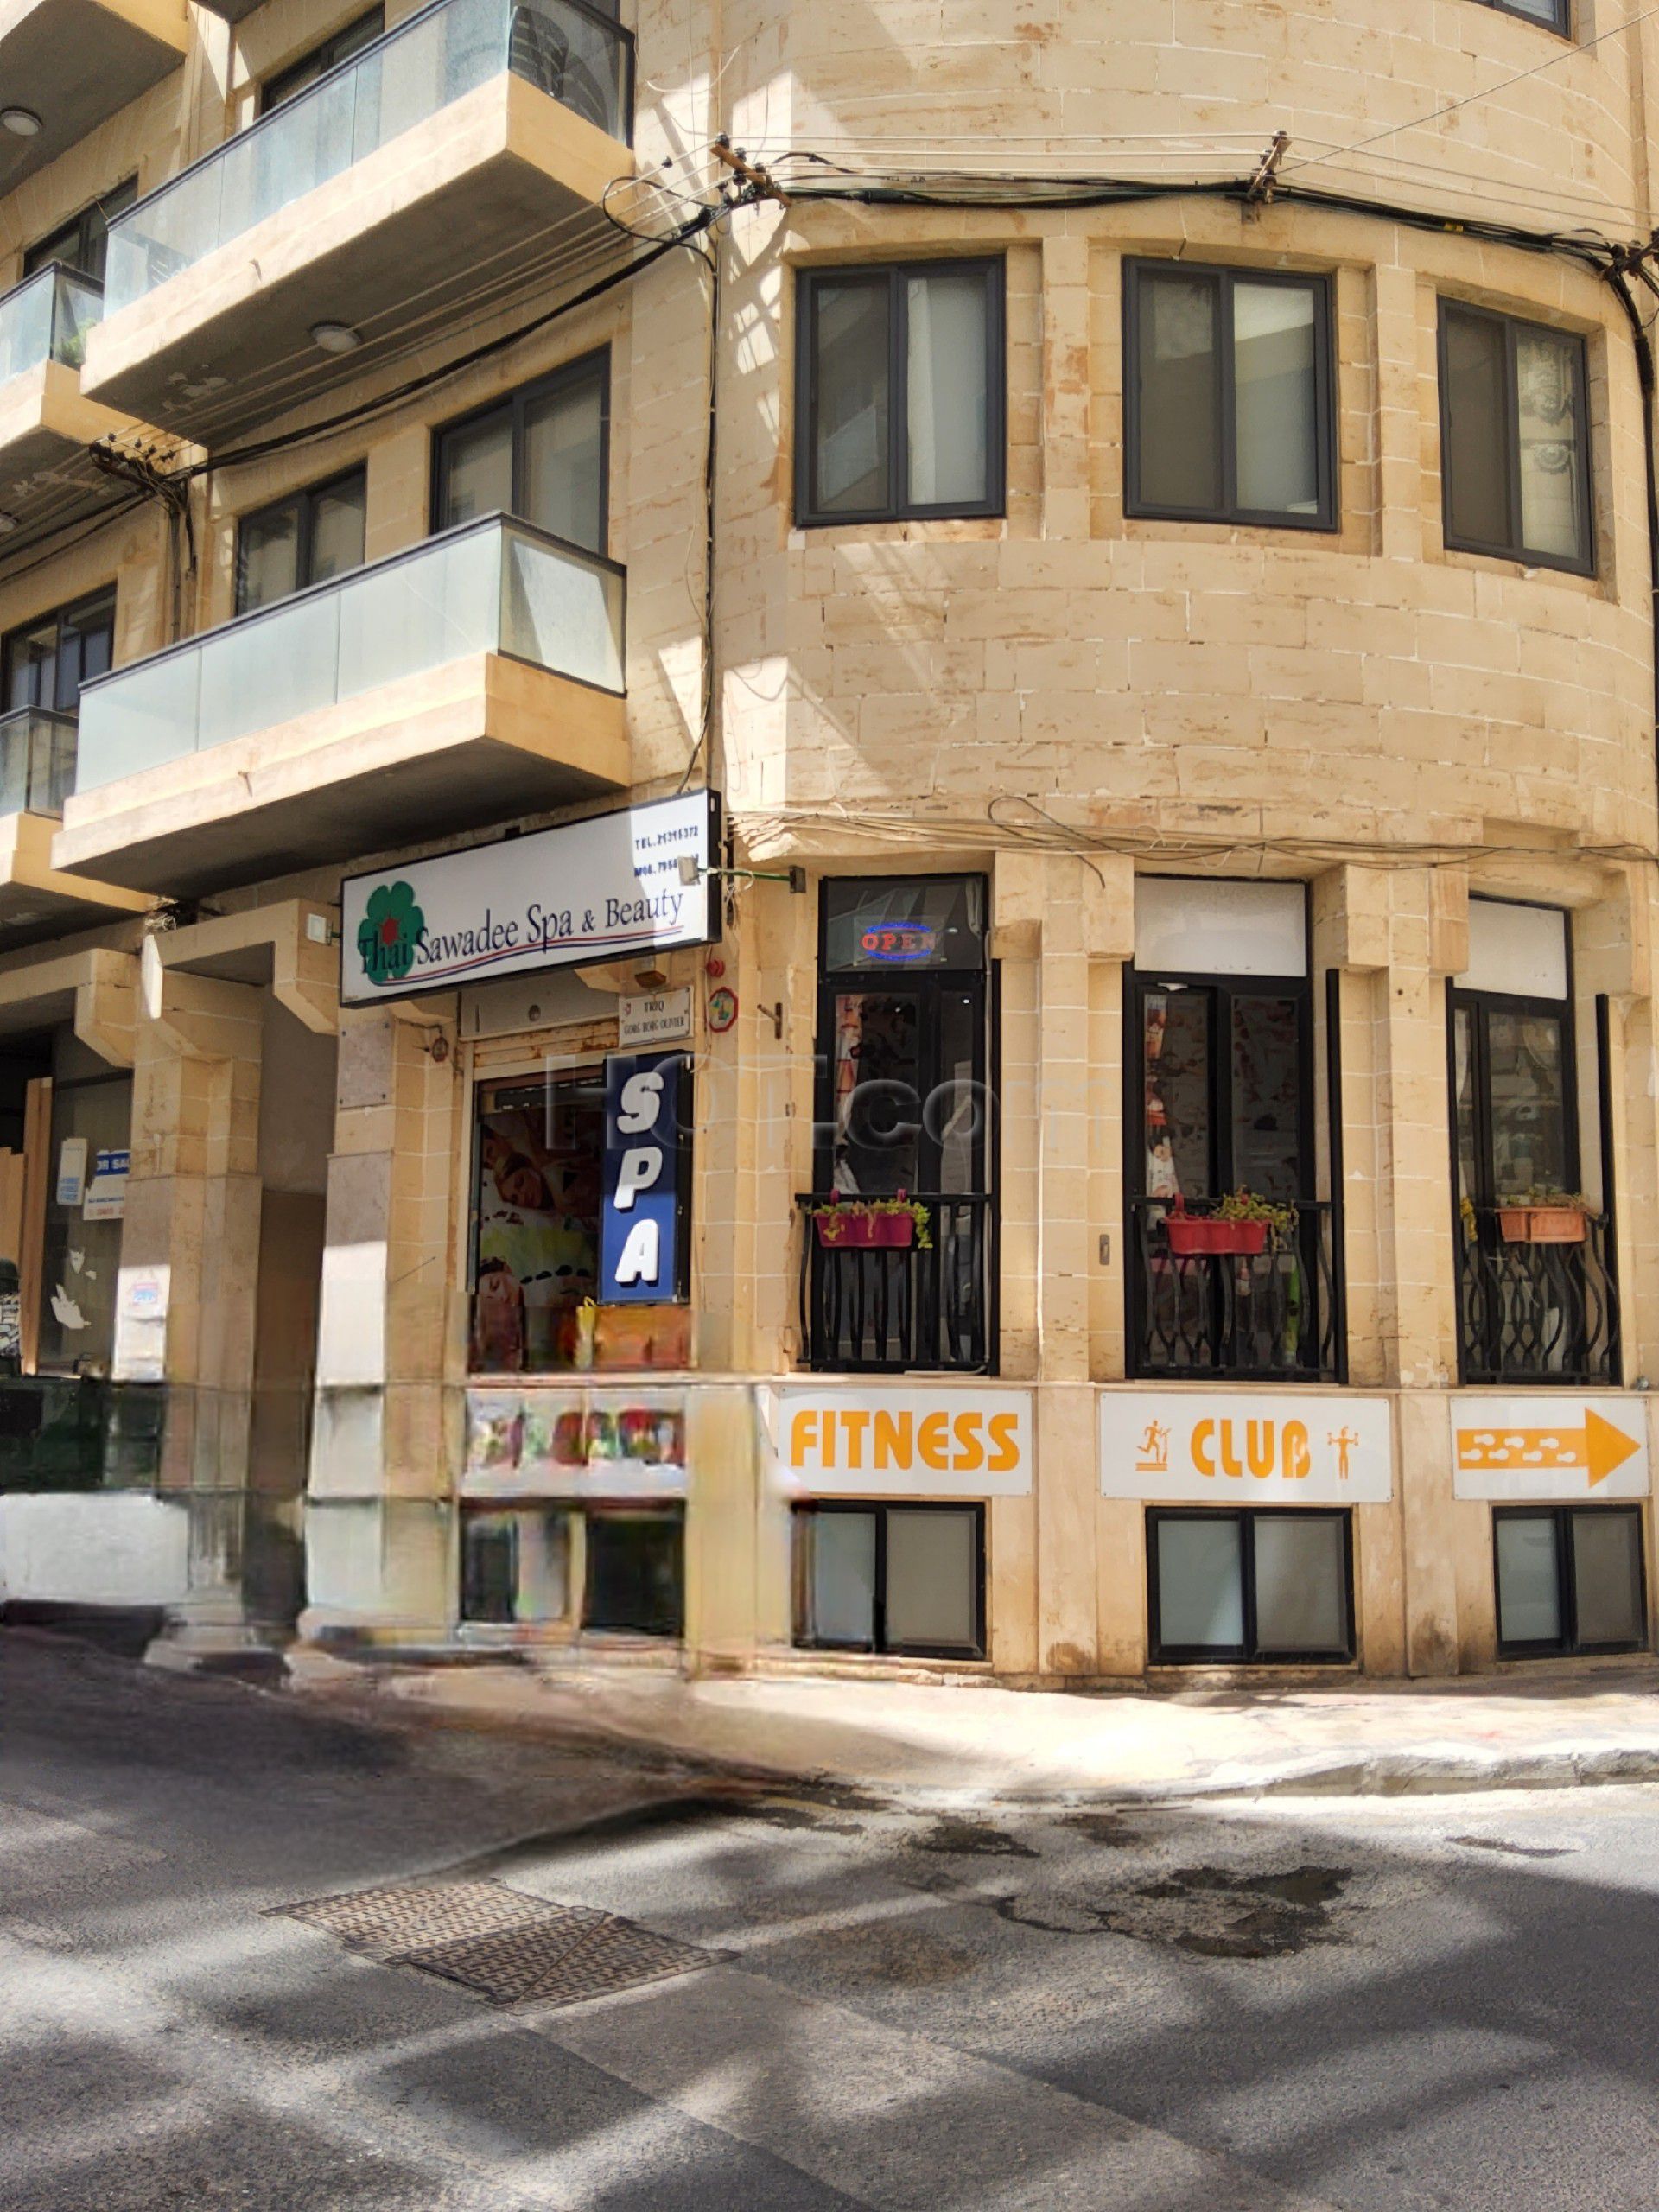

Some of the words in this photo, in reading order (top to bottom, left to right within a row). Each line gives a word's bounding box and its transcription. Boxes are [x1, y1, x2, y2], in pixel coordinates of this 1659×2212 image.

[358, 930, 410, 974] Thai
[416, 908, 519, 965] Sawadee
[527, 903, 574, 954] Spa
[582, 909, 596, 933] &
[606, 888, 684, 929] Beauty
[861, 933, 936, 950] OPEN
[613, 1071, 664, 1285] SPA
[791, 1409, 1020, 1471] FITNESS
[1191, 1418, 1312, 1478] CLUB
